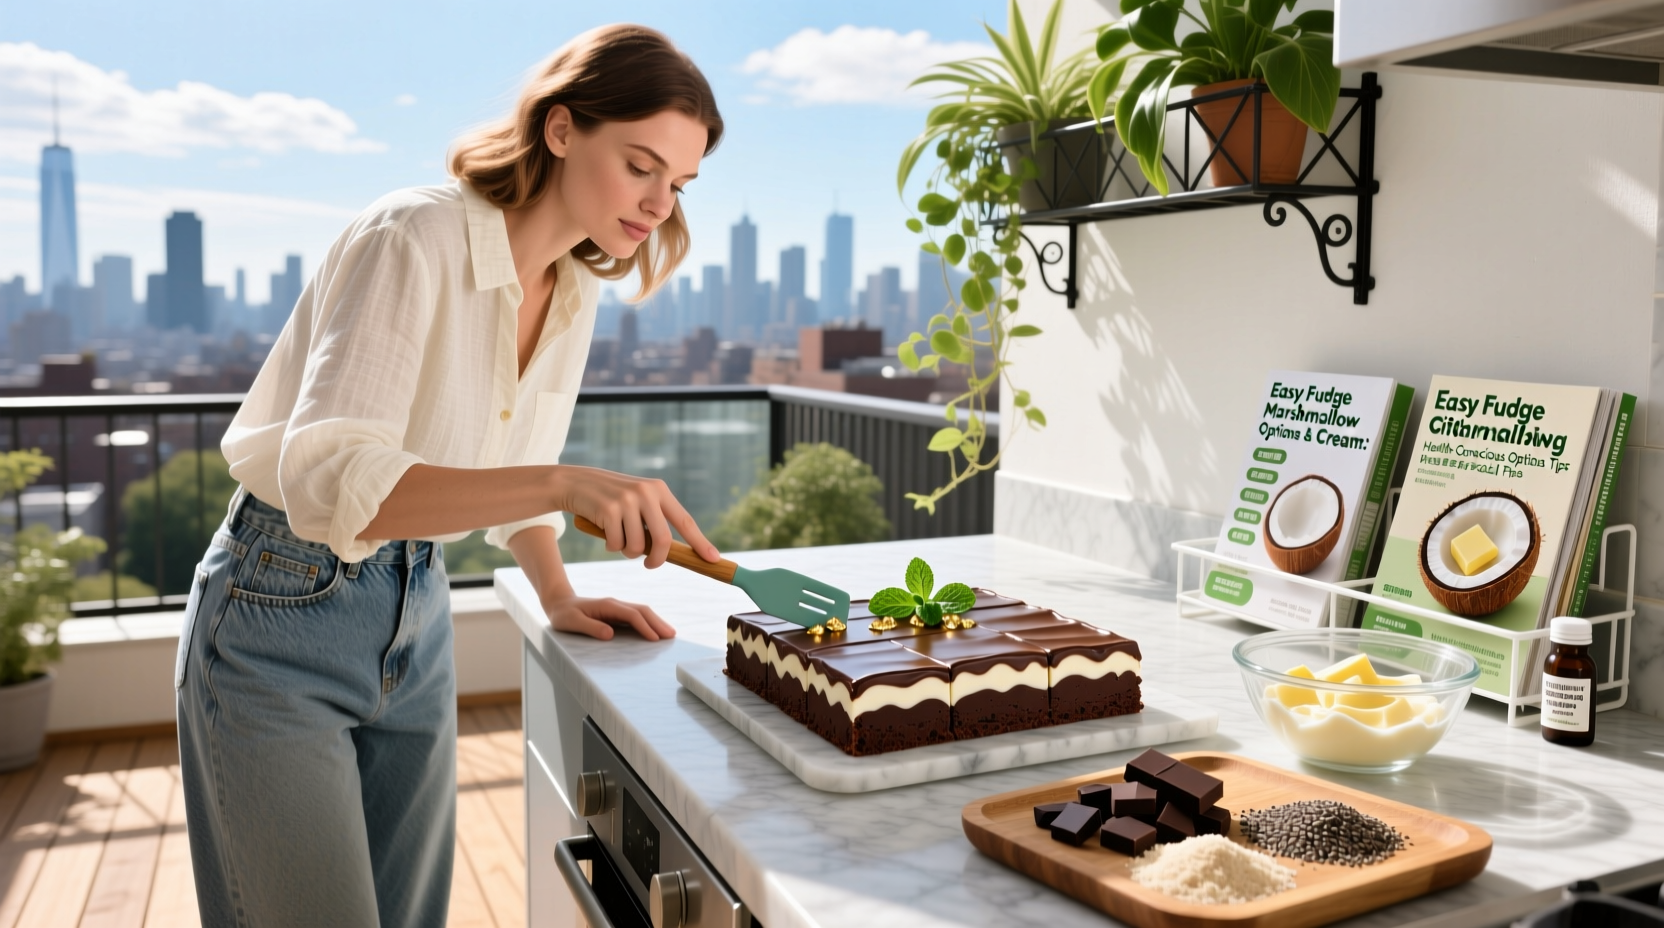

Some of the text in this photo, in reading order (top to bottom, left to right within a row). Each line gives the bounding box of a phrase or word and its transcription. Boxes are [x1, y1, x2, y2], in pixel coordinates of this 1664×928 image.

[1270, 382, 1352, 408] Easy Fudge
[1435, 389, 1545, 425] Easy Fudge
[1263, 402, 1360, 428] Marshmallow
